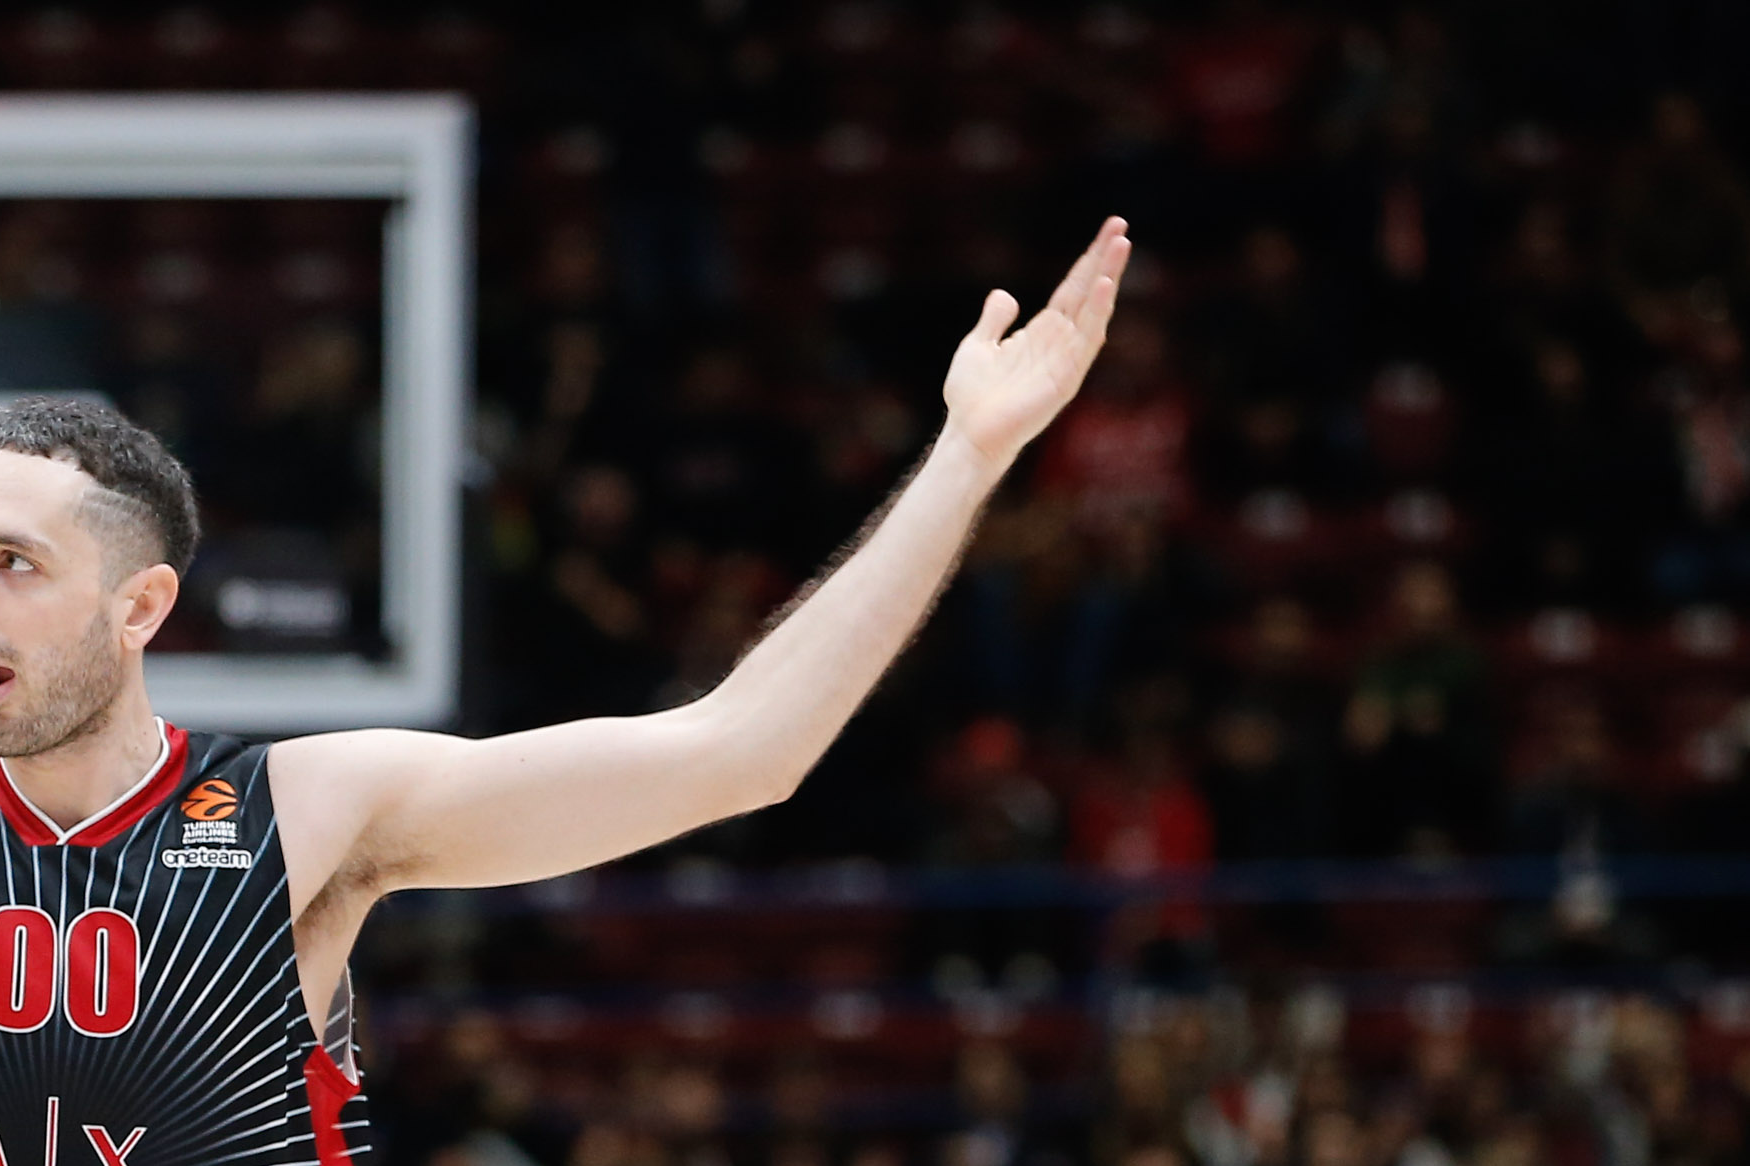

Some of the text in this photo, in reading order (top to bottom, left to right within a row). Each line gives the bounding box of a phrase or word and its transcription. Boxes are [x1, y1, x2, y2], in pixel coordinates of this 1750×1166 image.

[182, 821, 238, 831] TURKISH
[182, 829, 239, 839] AIRLINES
[163, 848, 251, 867] oneteam
